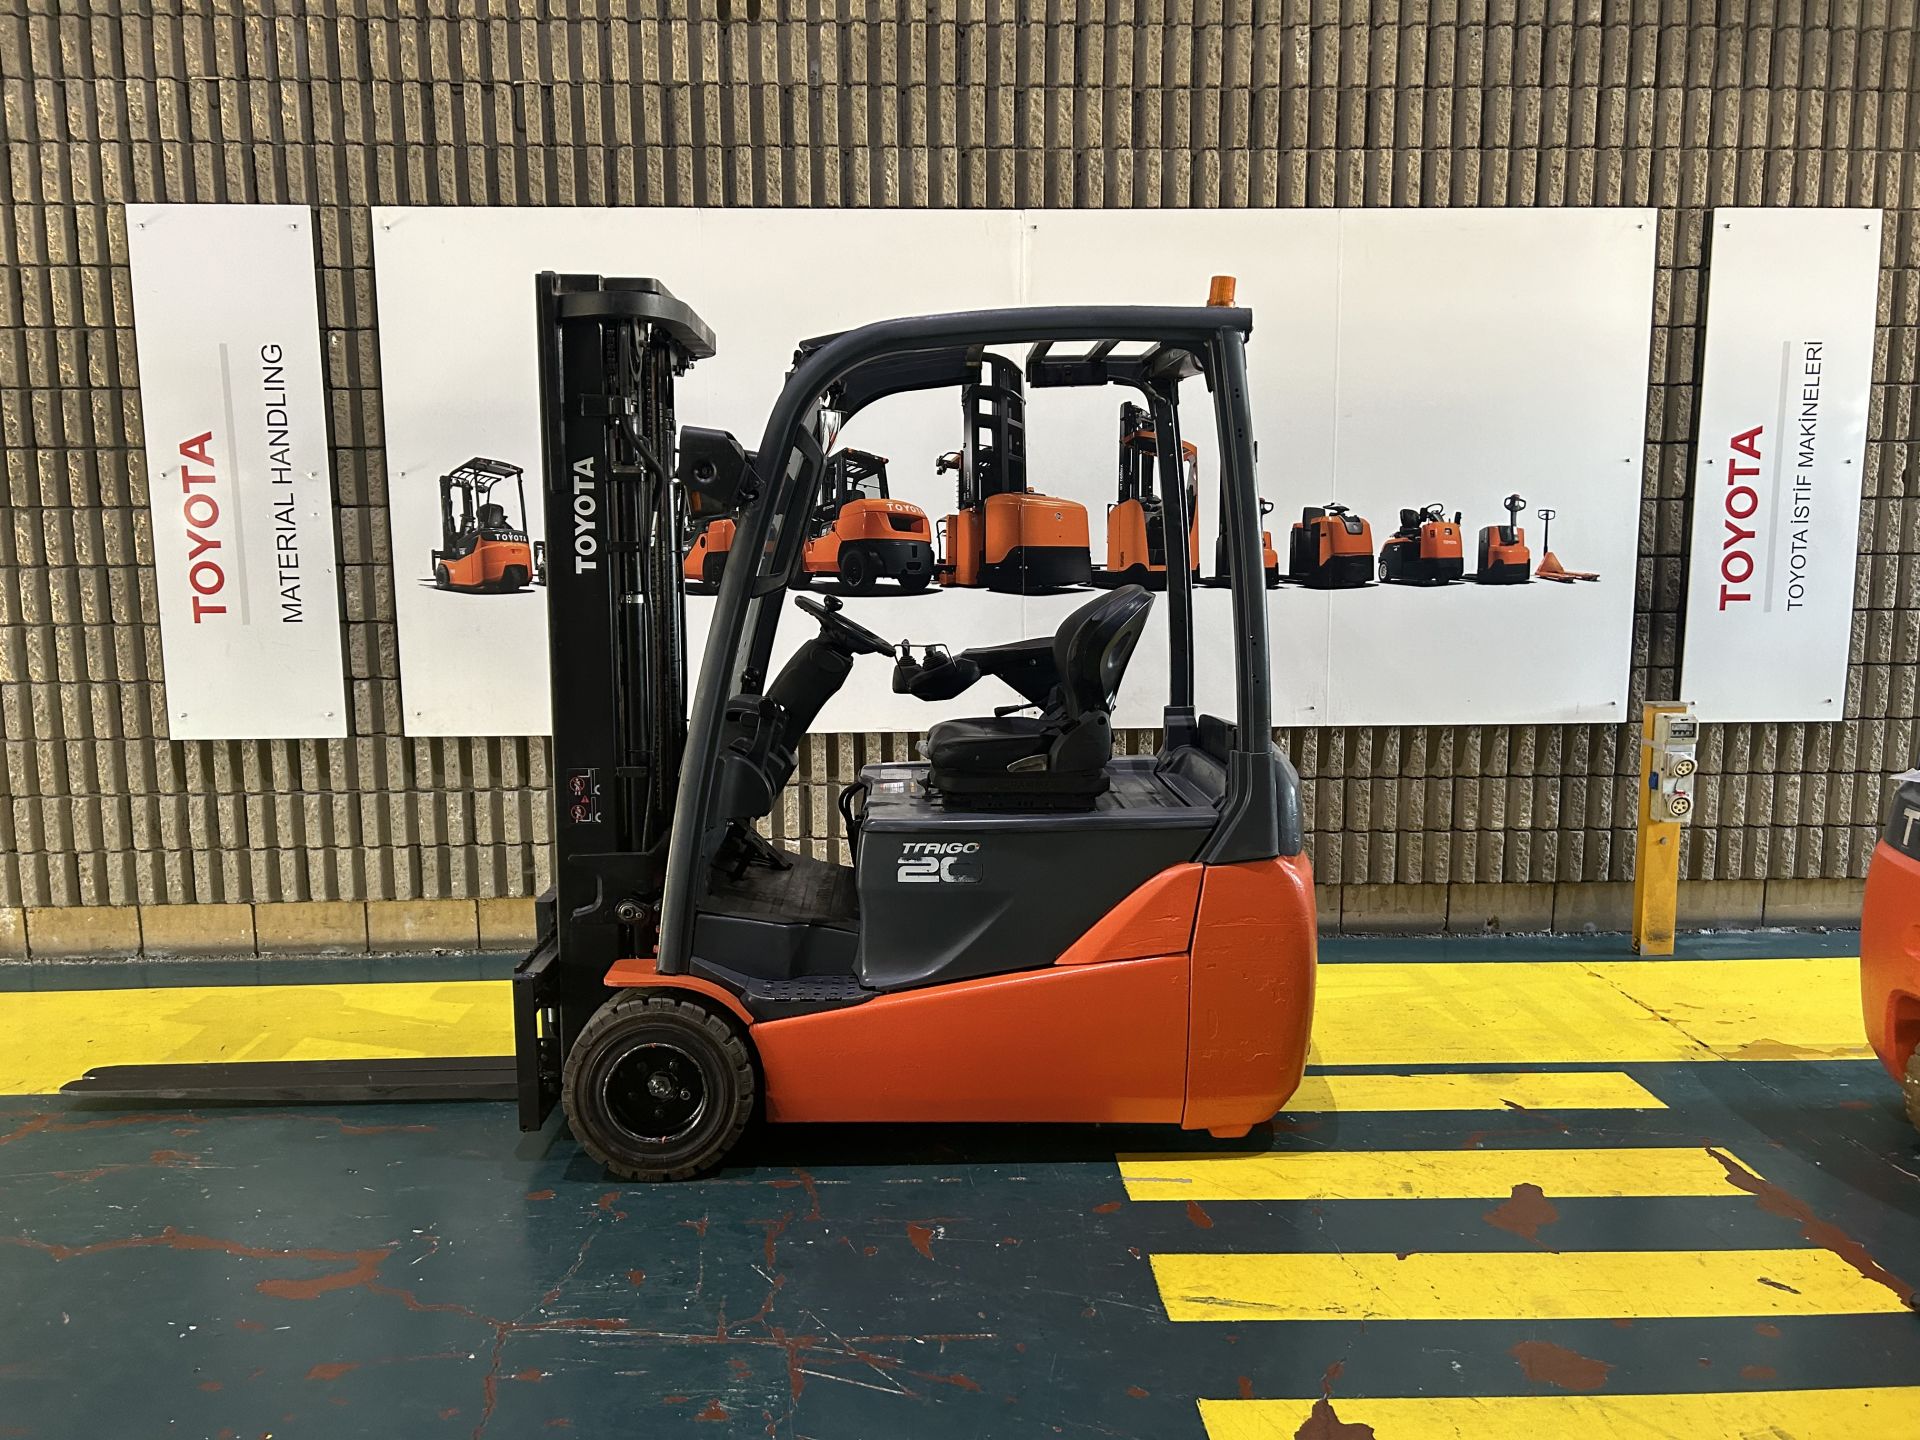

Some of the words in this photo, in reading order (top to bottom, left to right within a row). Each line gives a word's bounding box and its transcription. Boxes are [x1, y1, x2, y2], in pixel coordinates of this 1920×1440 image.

[260, 344, 293, 484] HANDLING
[1797, 340, 1823, 468] MAKİNELERİ
[179, 431, 227, 624] TOYOTA
[273, 493, 303, 623] MATERIAL
[573, 456, 597, 574] TOYOTA
[1719, 425, 1763, 611] TOYOTA
[1790, 474, 1812, 525] İSTİF
[1786, 529, 1808, 612] TOYOTA
